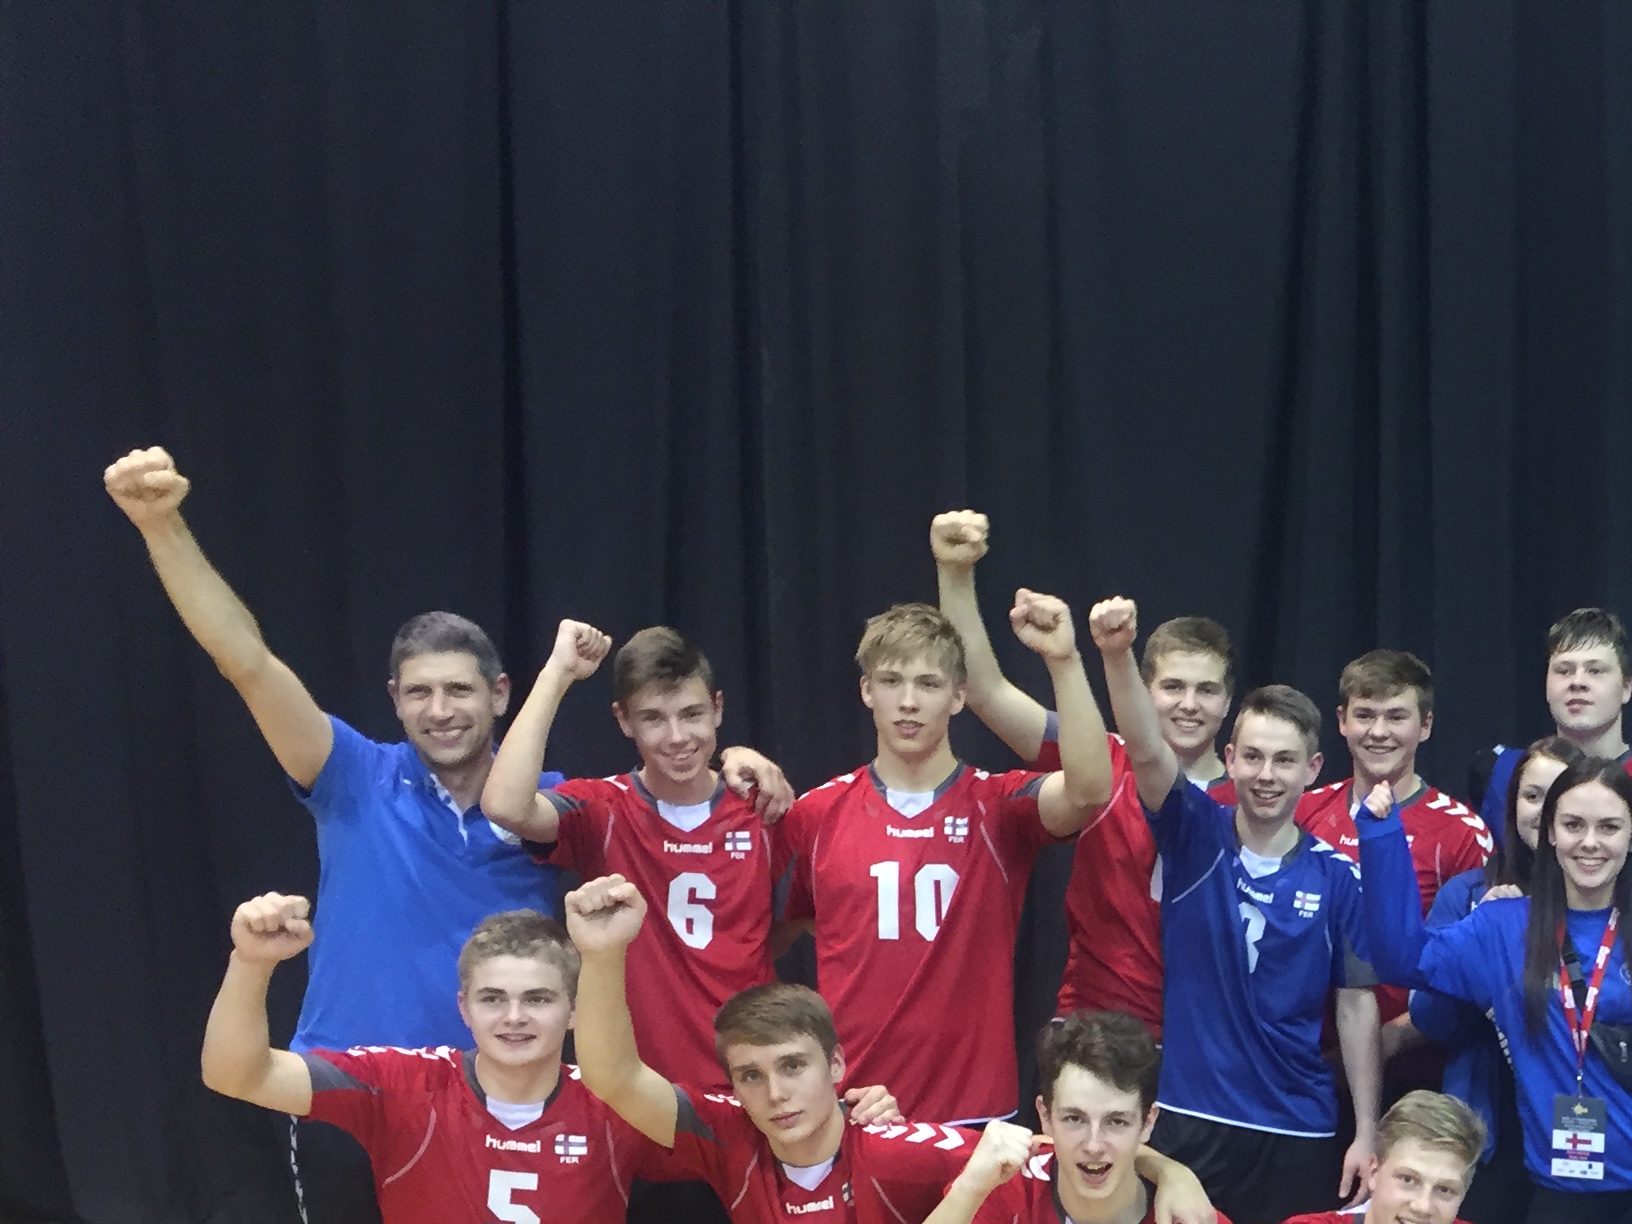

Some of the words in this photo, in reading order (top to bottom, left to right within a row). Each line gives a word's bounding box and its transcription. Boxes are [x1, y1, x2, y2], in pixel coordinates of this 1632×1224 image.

[667, 871, 717, 950] 6
[869, 860, 960, 942] 10
[485, 1133, 541, 1153] hummel
[786, 1195, 834, 1215] hummel
